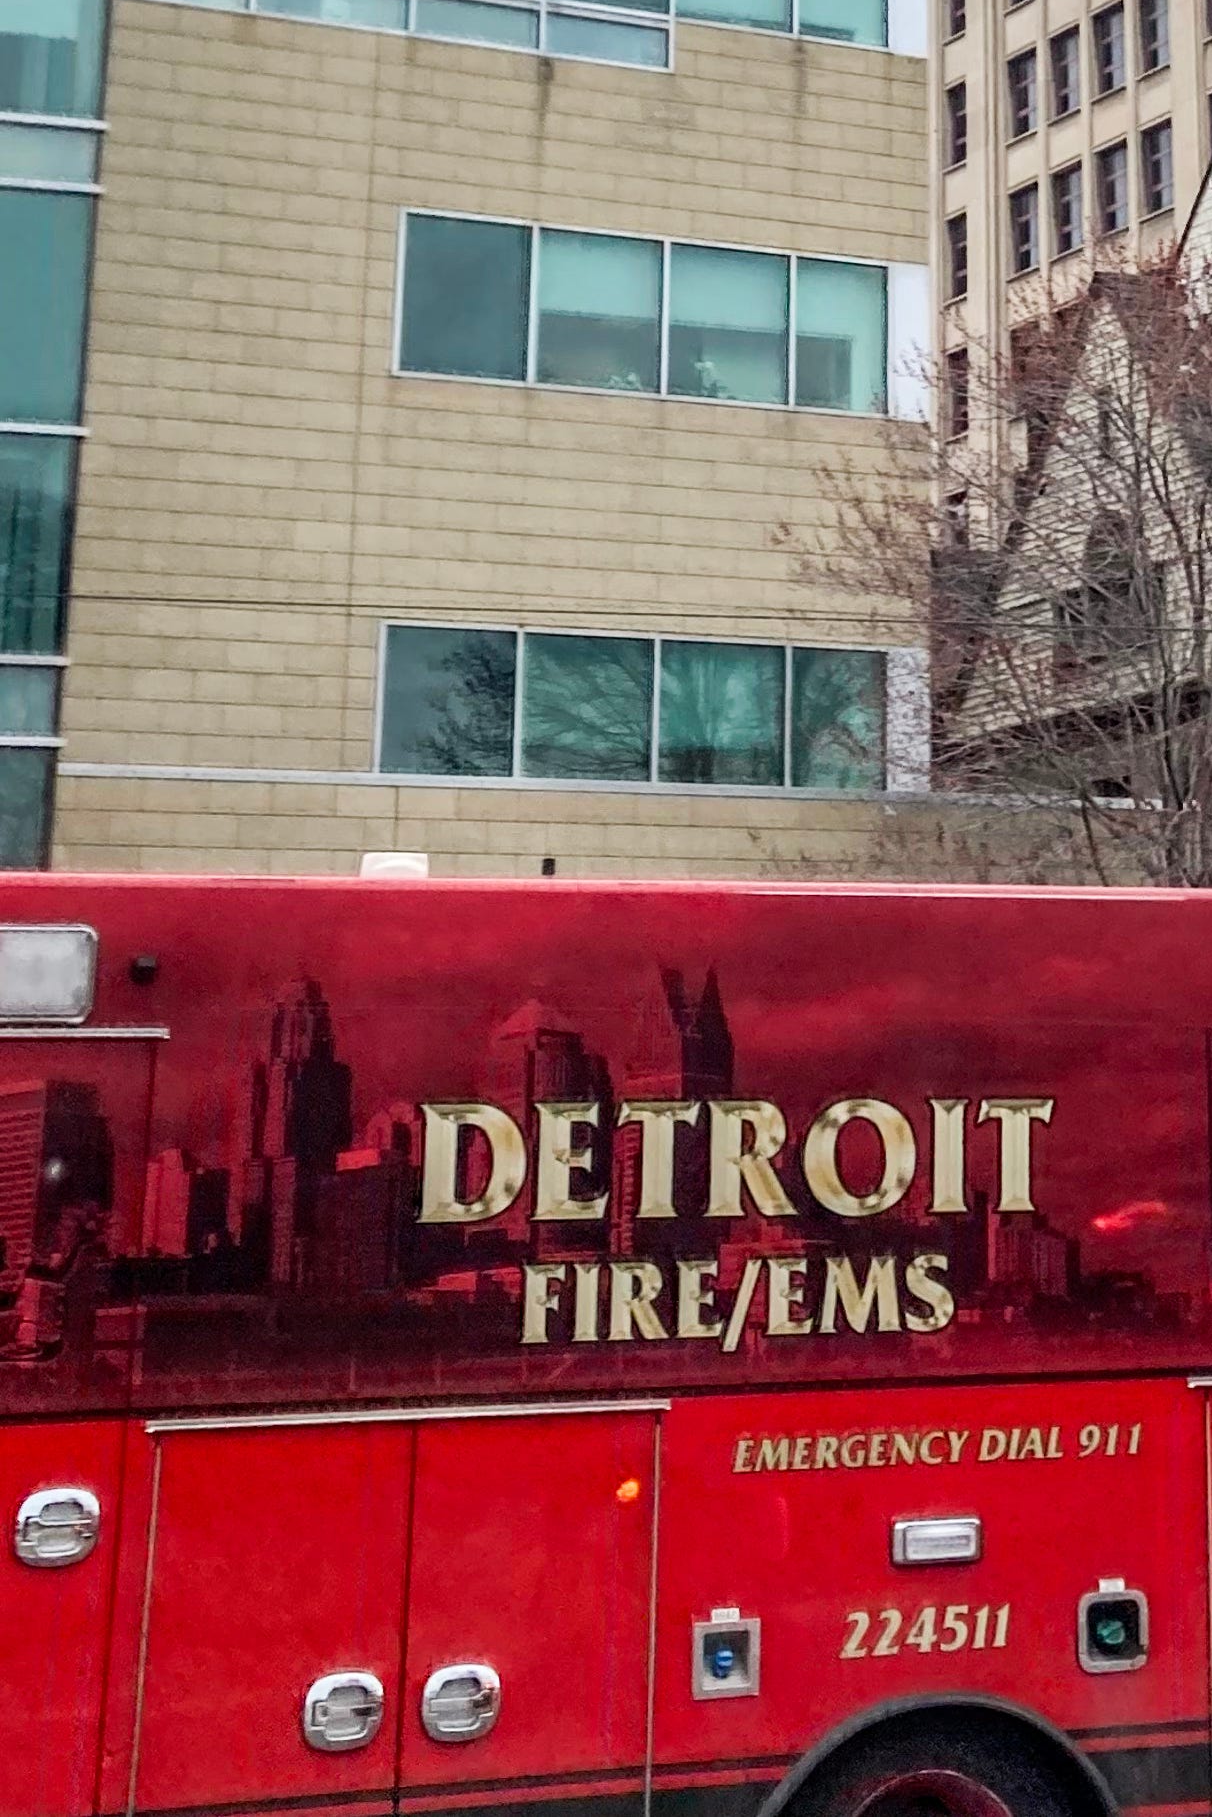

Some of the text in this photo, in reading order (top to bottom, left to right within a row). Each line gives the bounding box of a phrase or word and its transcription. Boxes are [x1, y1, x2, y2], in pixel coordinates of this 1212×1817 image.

[415, 1097, 1055, 1224] DETROIT
[519, 1253, 956, 1352] FIRE/EMS
[732, 1422, 1142, 1474] EMERGENCY DIAL 911
[838, 1602, 1011, 1660] 224511
